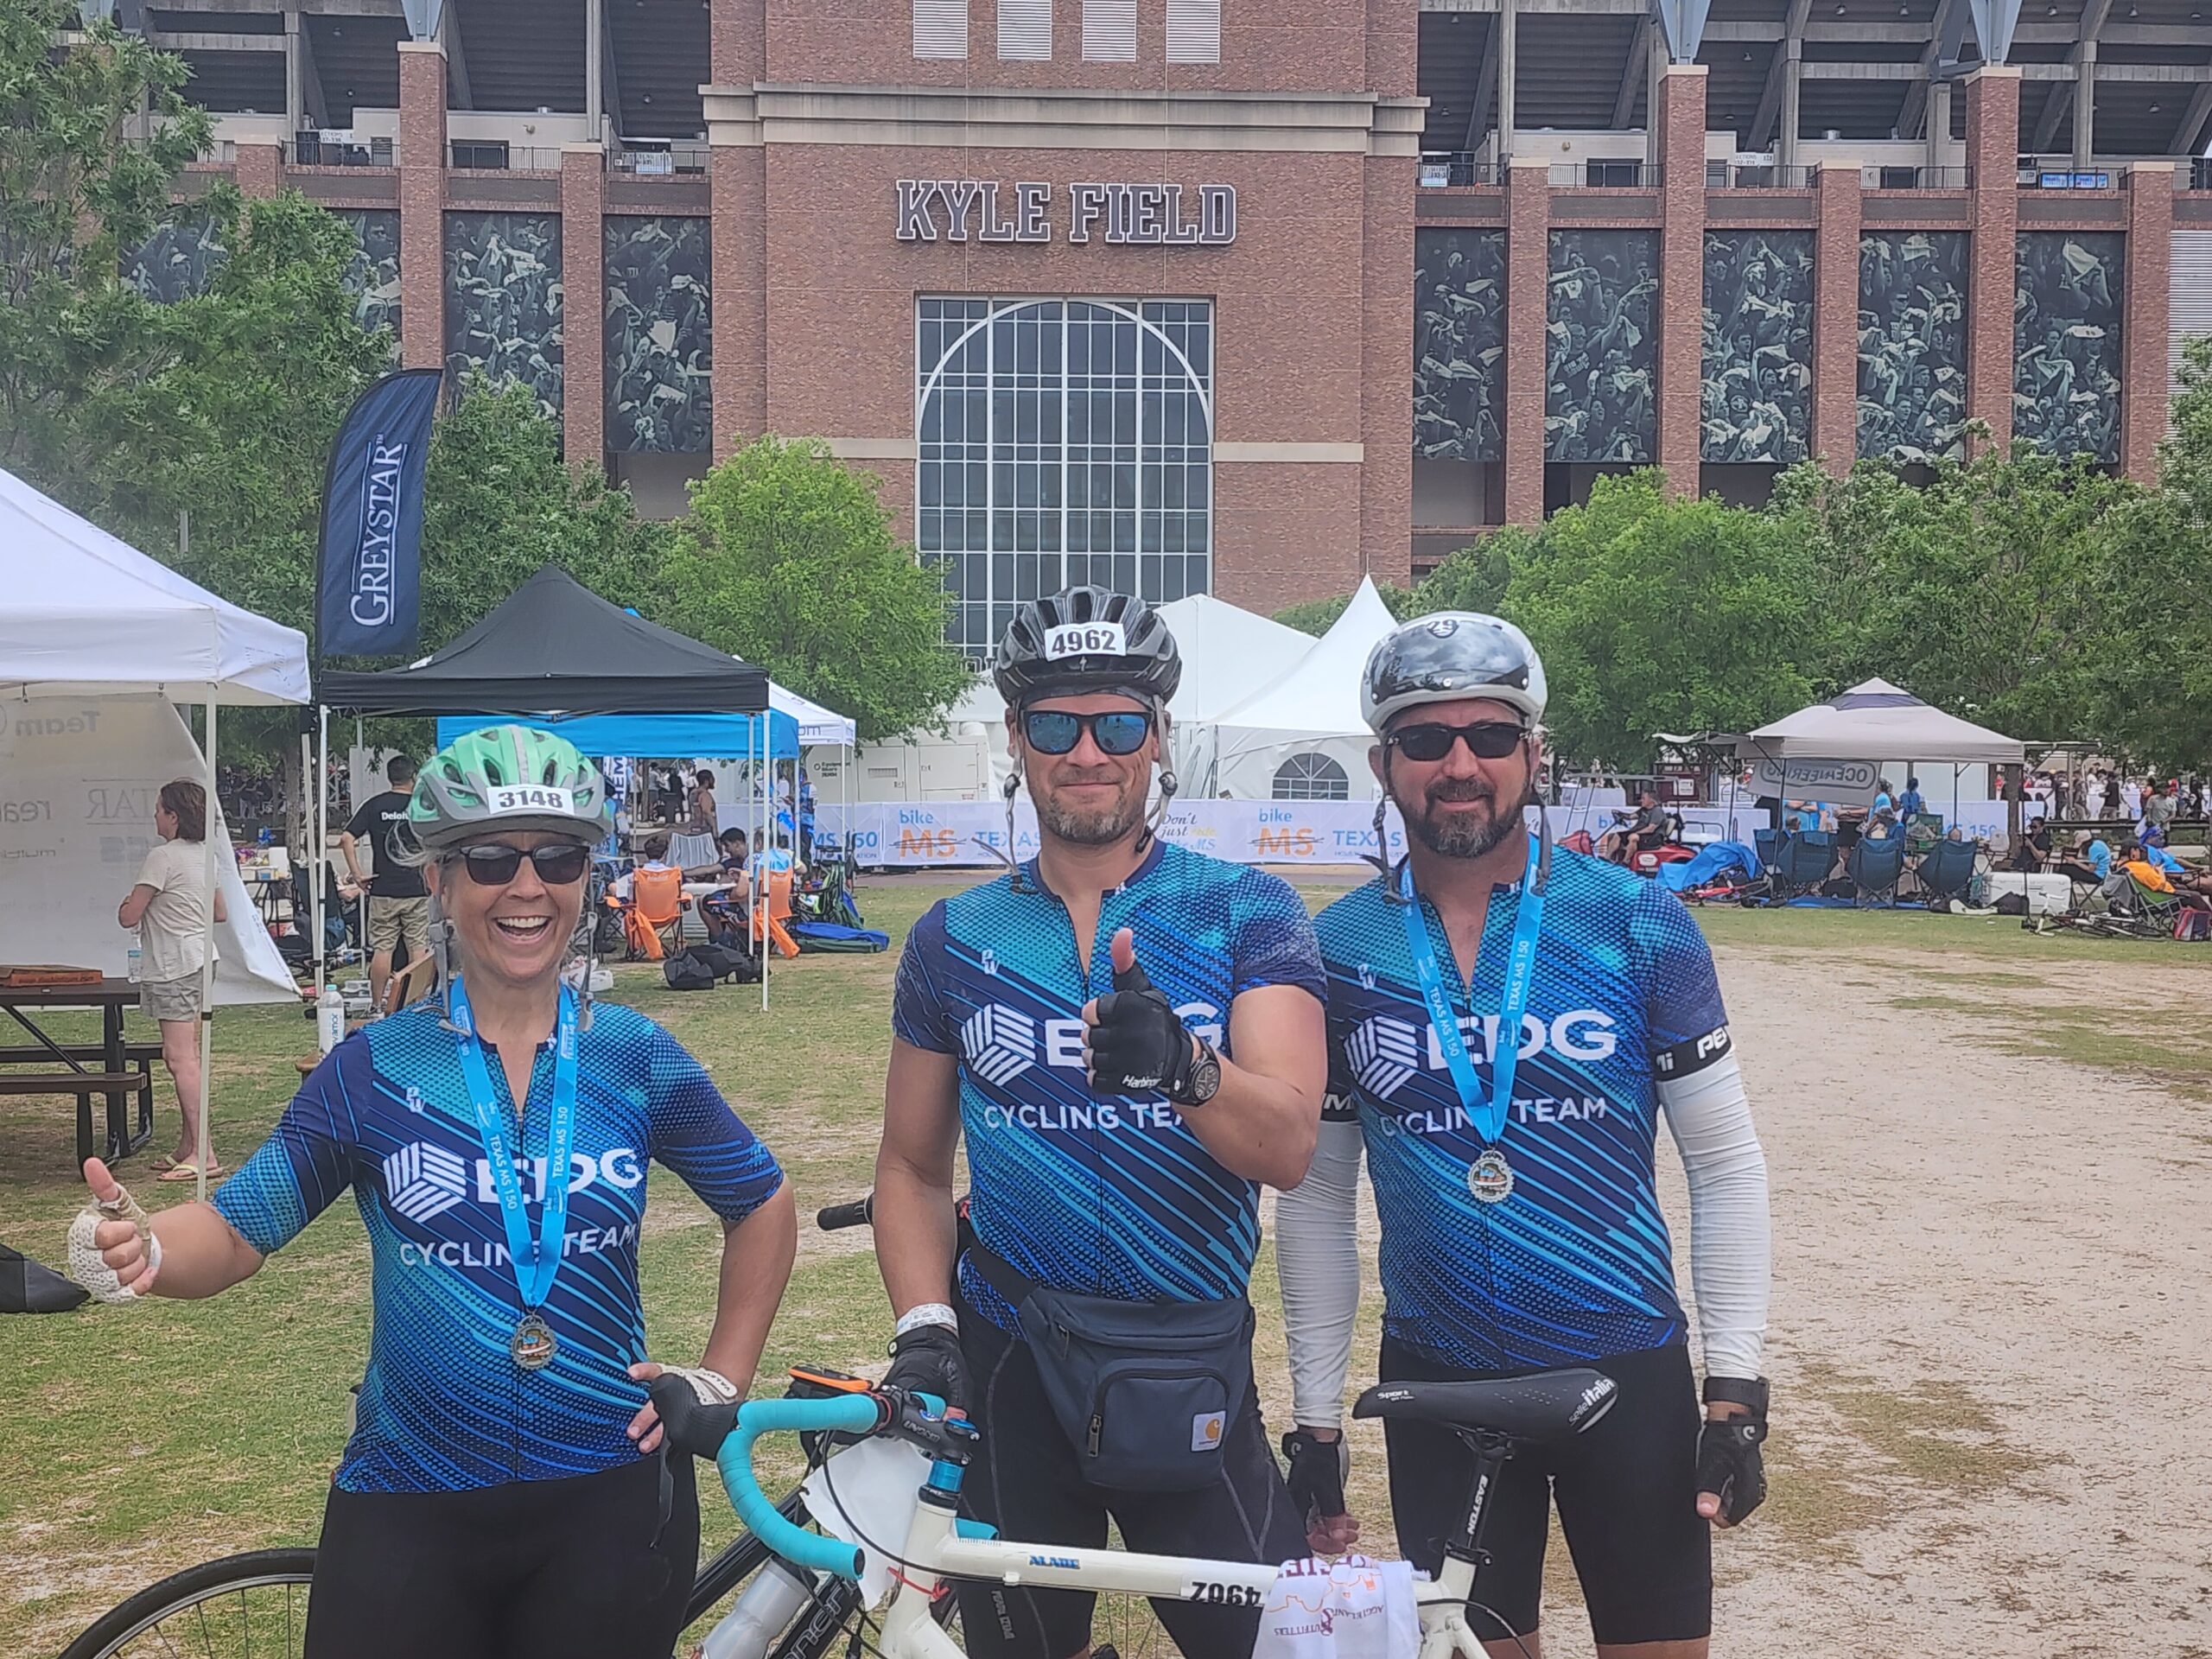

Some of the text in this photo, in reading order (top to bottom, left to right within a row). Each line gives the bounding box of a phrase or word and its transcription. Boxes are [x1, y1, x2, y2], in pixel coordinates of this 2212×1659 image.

[896, 180, 1236, 244] KYLE FIELD
[350, 442, 403, 626] GREYSTAR
[1052, 629, 1116, 654] 4962
[498, 790, 563, 809] 3148
[1259, 808, 1293, 823] bike
[899, 810, 934, 823] bike
[1159, 826, 1188, 839] just
[899, 829, 956, 857] MS
[1258, 827, 1313, 856] MS
[1046, 1002, 1223, 1067] EG
[1427, 1009, 1617, 1071] EDG
[983, 1103, 1184, 1130] CYCLING TE
[1381, 1097, 1606, 1137] CYCLIN TEAM
[488, 1135, 508, 1167] TEXAS
[504, 1189, 518, 1211] 150
[552, 1147, 566, 1179] TEXAS
[400, 1224, 638, 1267] CYCLIN TEAM
[1467, 1474, 1490, 1535] EASTON
